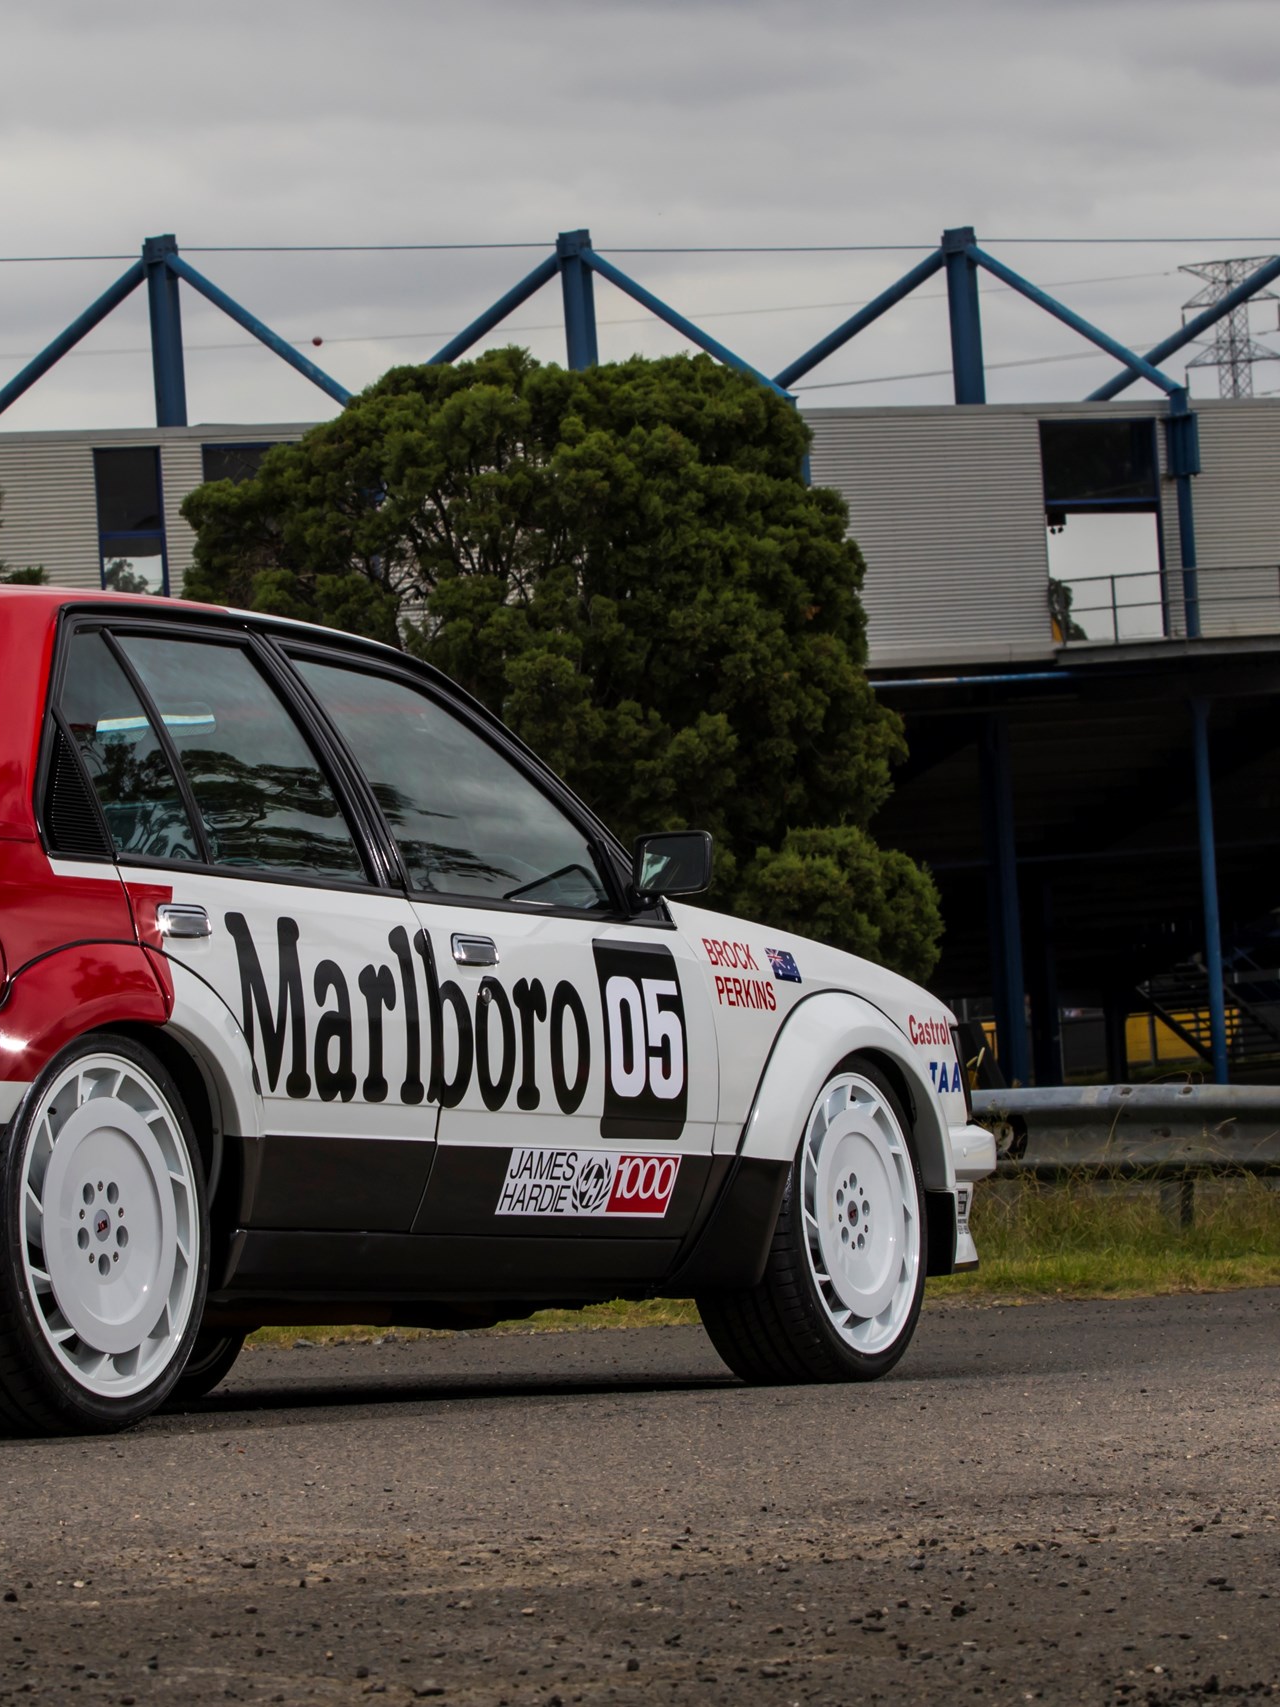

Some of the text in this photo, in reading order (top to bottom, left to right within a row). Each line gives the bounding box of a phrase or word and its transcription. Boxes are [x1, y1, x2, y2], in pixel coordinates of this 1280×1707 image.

[701, 938, 760, 971] BROCK
[714, 975, 777, 1012] PERKINS
[223, 911, 591, 1116] Marlboro
[908, 1014, 951, 1046] Castrol
[605, 975, 683, 1100] 05
[929, 1061, 962, 1094] TAA
[509, 1150, 579, 1182] JAMES
[615, 1157, 677, 1200] 1000
[498, 1182, 572, 1213] HARDIE
